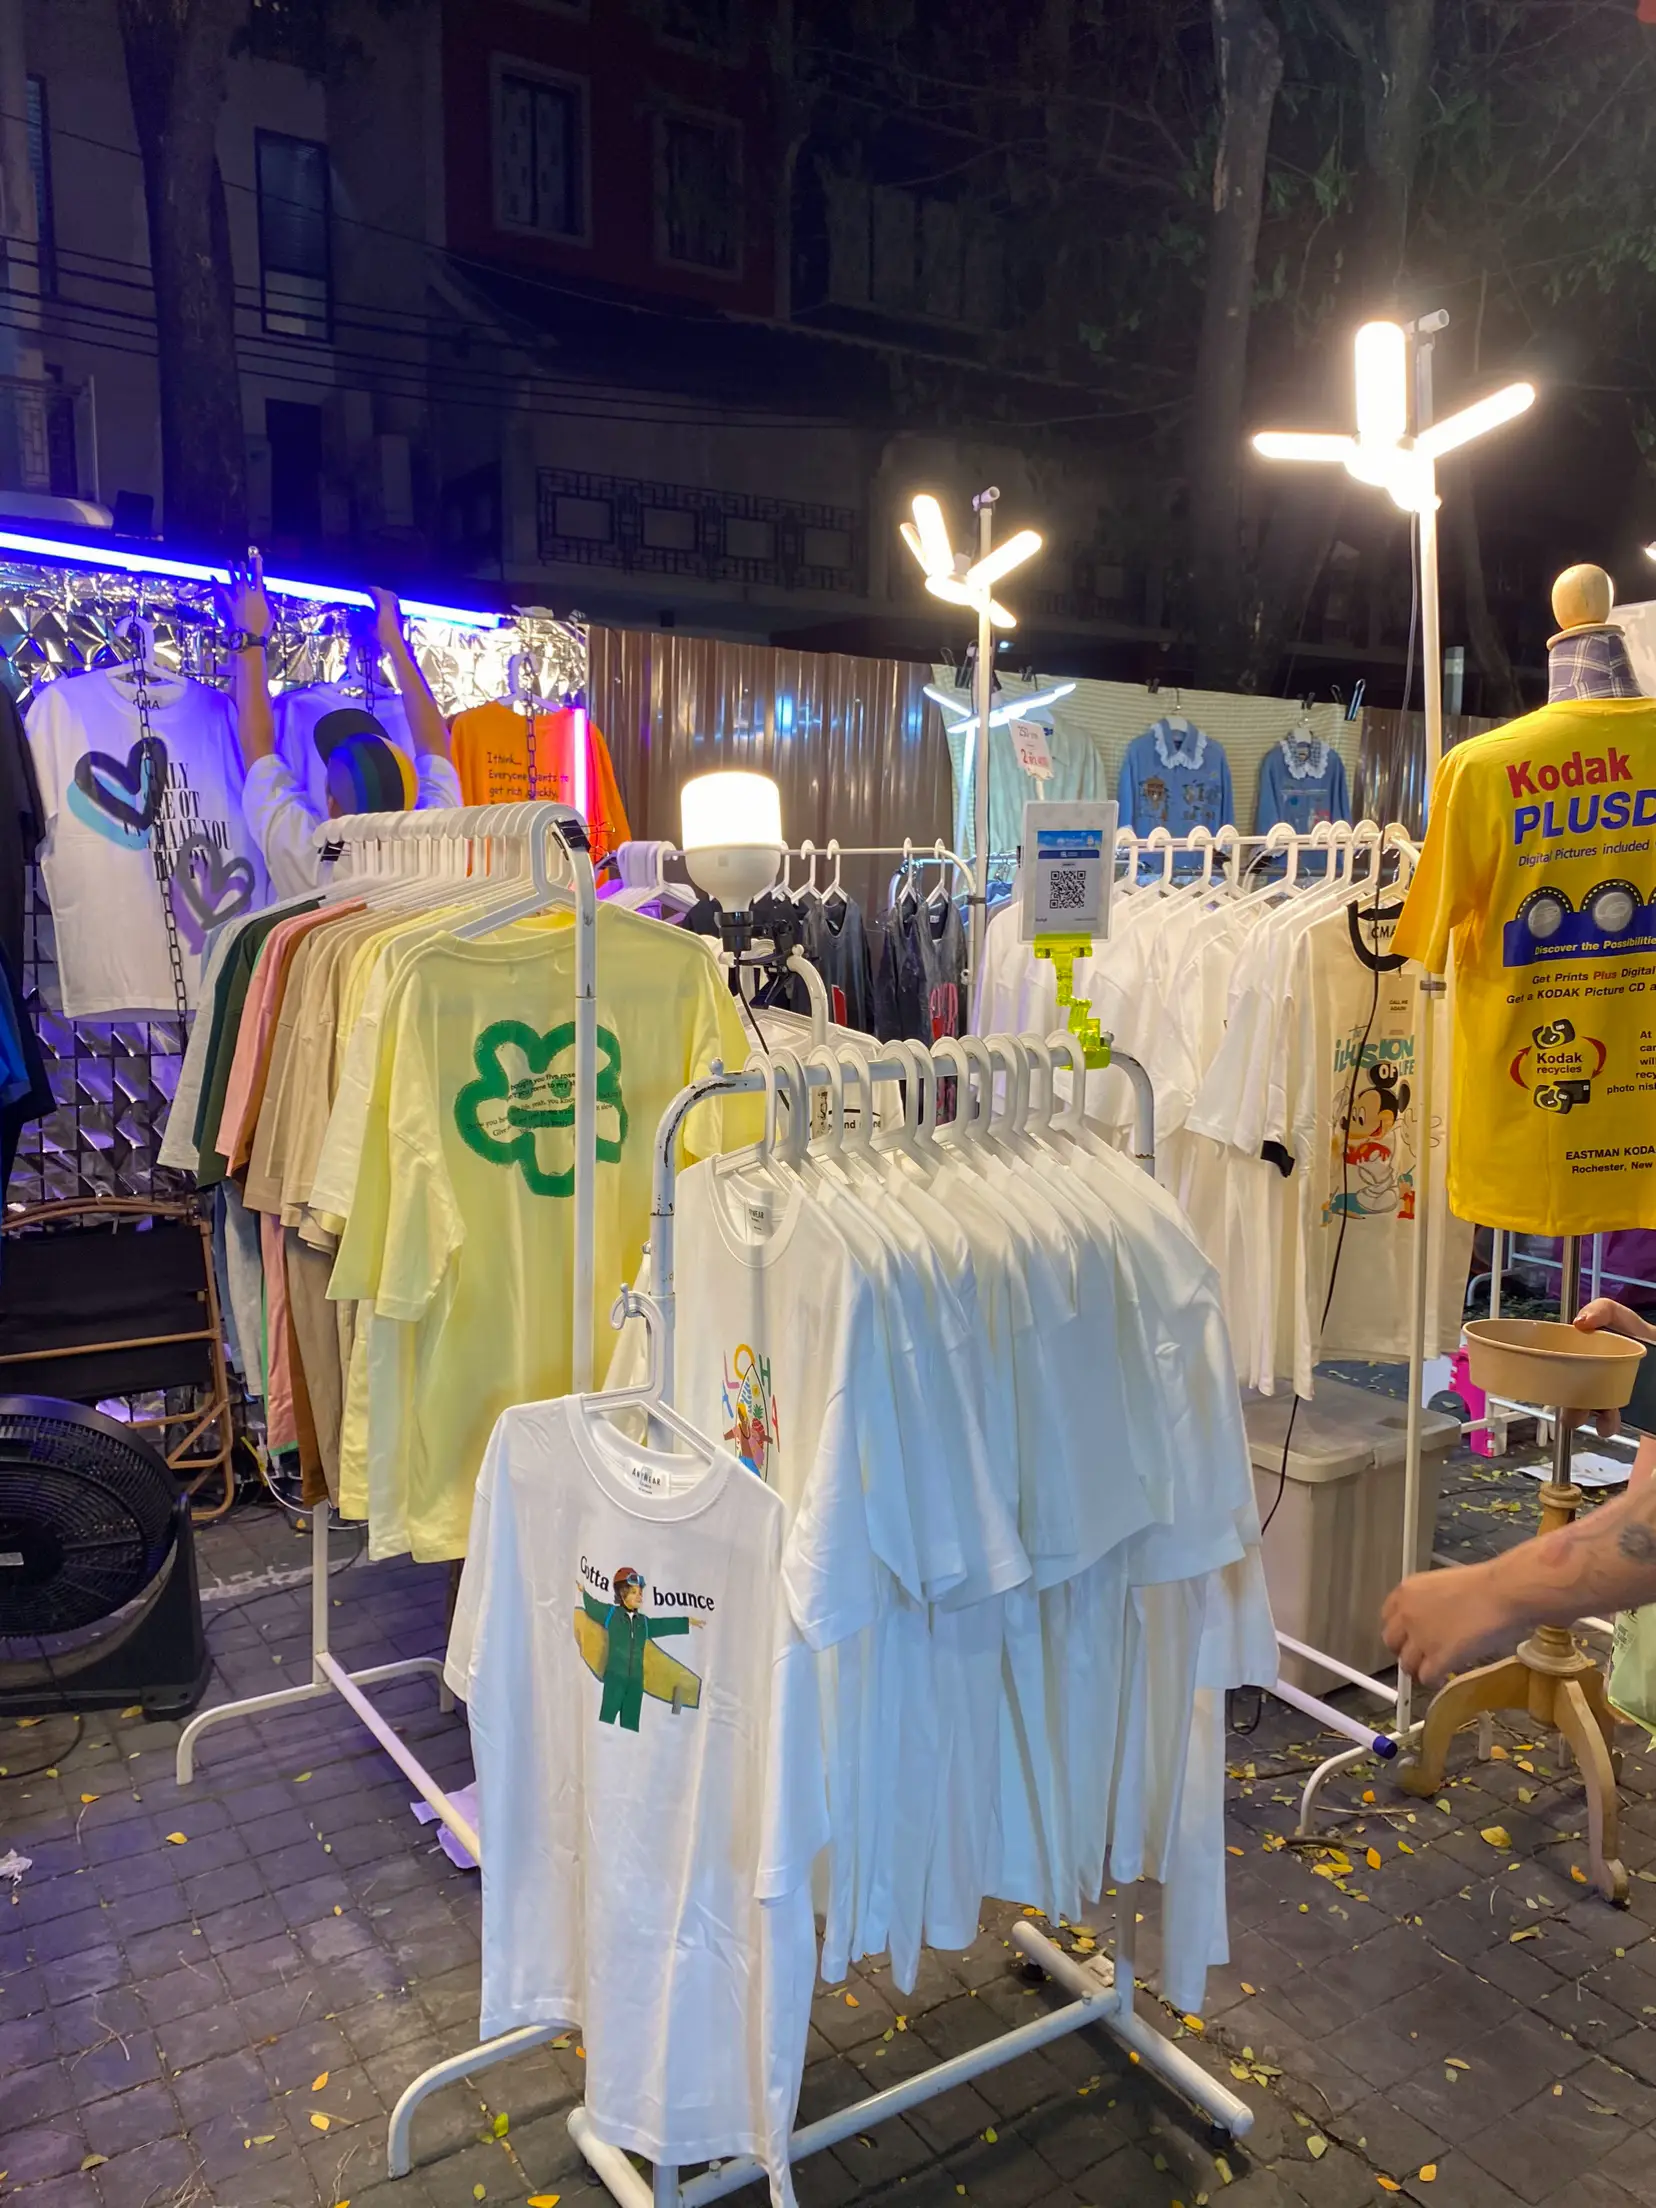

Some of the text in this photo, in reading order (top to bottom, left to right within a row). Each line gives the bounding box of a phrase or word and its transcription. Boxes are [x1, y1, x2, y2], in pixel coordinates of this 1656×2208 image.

[1506, 747, 1633, 799] Kodak
[489, 785, 504, 798] get
[507, 786, 522, 796] rich
[1518, 839, 1650, 867] Digital Pictures included
[1534, 943, 1578, 956] Discover
[1581, 941, 1600, 951] the
[1532, 965, 1656, 985] Get Prints Plus Digital
[1506, 993, 1524, 1004] Get
[1527, 993, 1534, 1001] a
[1536, 987, 1580, 1000] KODAK
[1584, 985, 1625, 997] Picture
[1628, 981, 1646, 992] CD
[1640, 1030, 1653, 1039] At
[1537, 1052, 1582, 1064] Kodak
[1378, 1064, 1396, 1079] OF
[1537, 1065, 1582, 1075] recycles
[1606, 1083, 1635, 1095] photo
[1565, 1147, 1620, 1161] EASTMAN
[1571, 1161, 1653, 1174] Rochester, New
[580, 1555, 715, 1611] Gotta bounce
